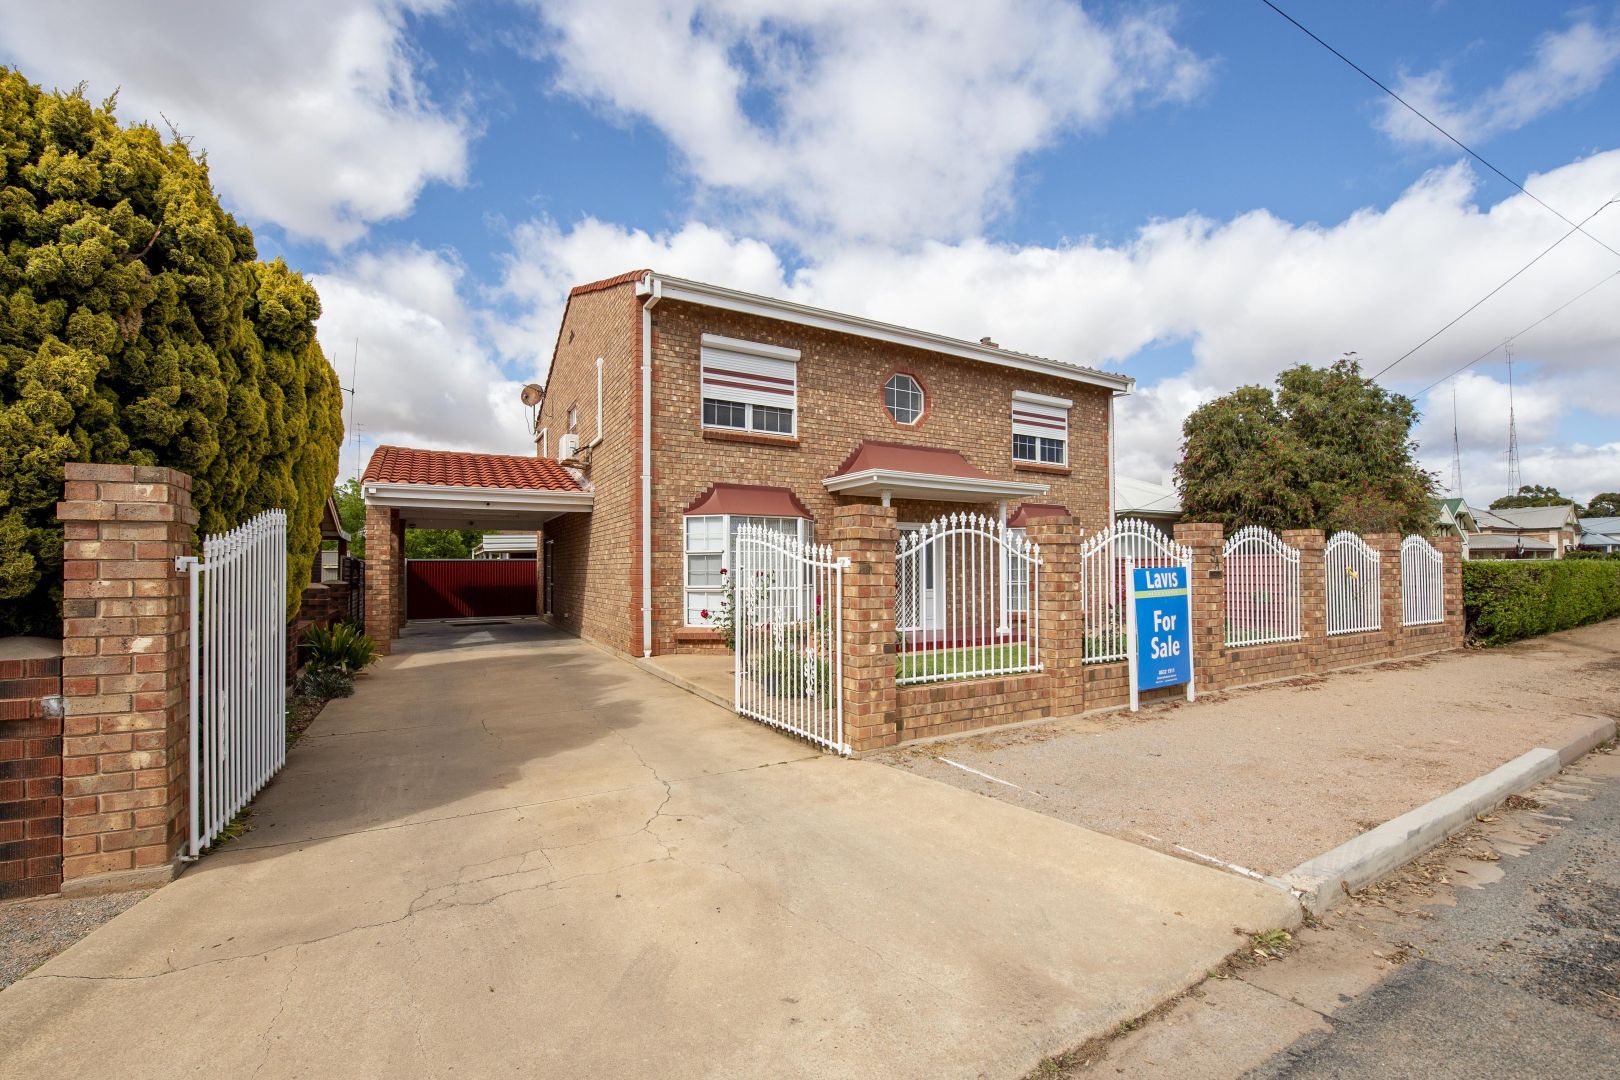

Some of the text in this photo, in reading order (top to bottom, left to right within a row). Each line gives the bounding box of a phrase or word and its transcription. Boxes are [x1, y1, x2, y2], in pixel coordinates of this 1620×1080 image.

[1145, 570, 1179, 589] Lavis
[1153, 610, 1176, 633] For
[1151, 635, 1180, 659] Sale
